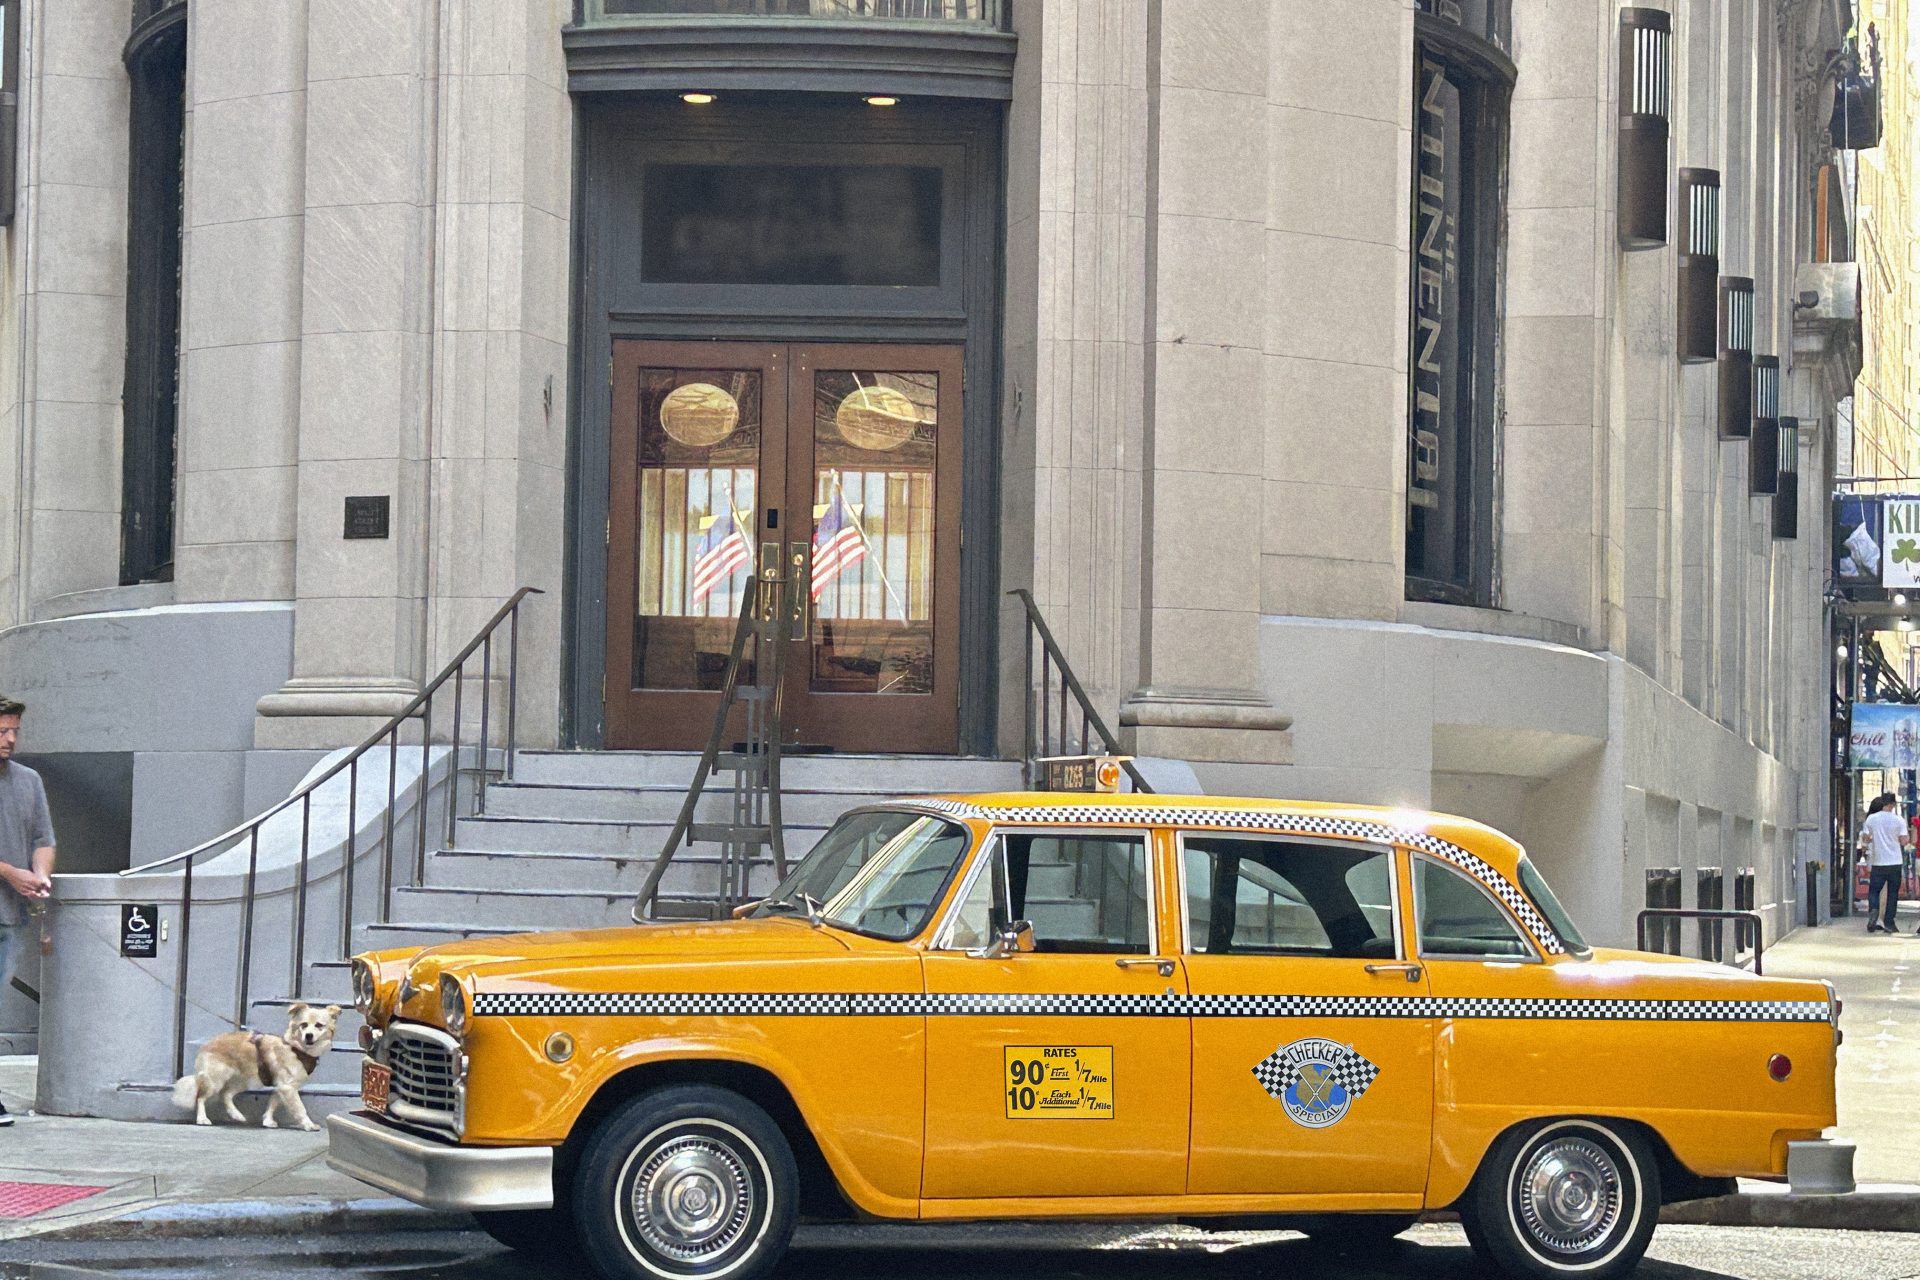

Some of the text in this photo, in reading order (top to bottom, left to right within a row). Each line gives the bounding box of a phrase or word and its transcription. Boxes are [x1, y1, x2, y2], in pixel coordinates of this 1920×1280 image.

[1043, 1048, 1077, 1058] RATES
[1287, 1042, 1344, 1064] CHECKER
[1050, 1067, 1070, 1077] First
[1089, 1075, 1107, 1083] Mile
[1038, 1097, 1080, 1105] Additional
[1050, 1089, 1072, 1099] Each
[1093, 1102, 1112, 1110] Mile
[1293, 1105, 1340, 1122] SPECIAL
